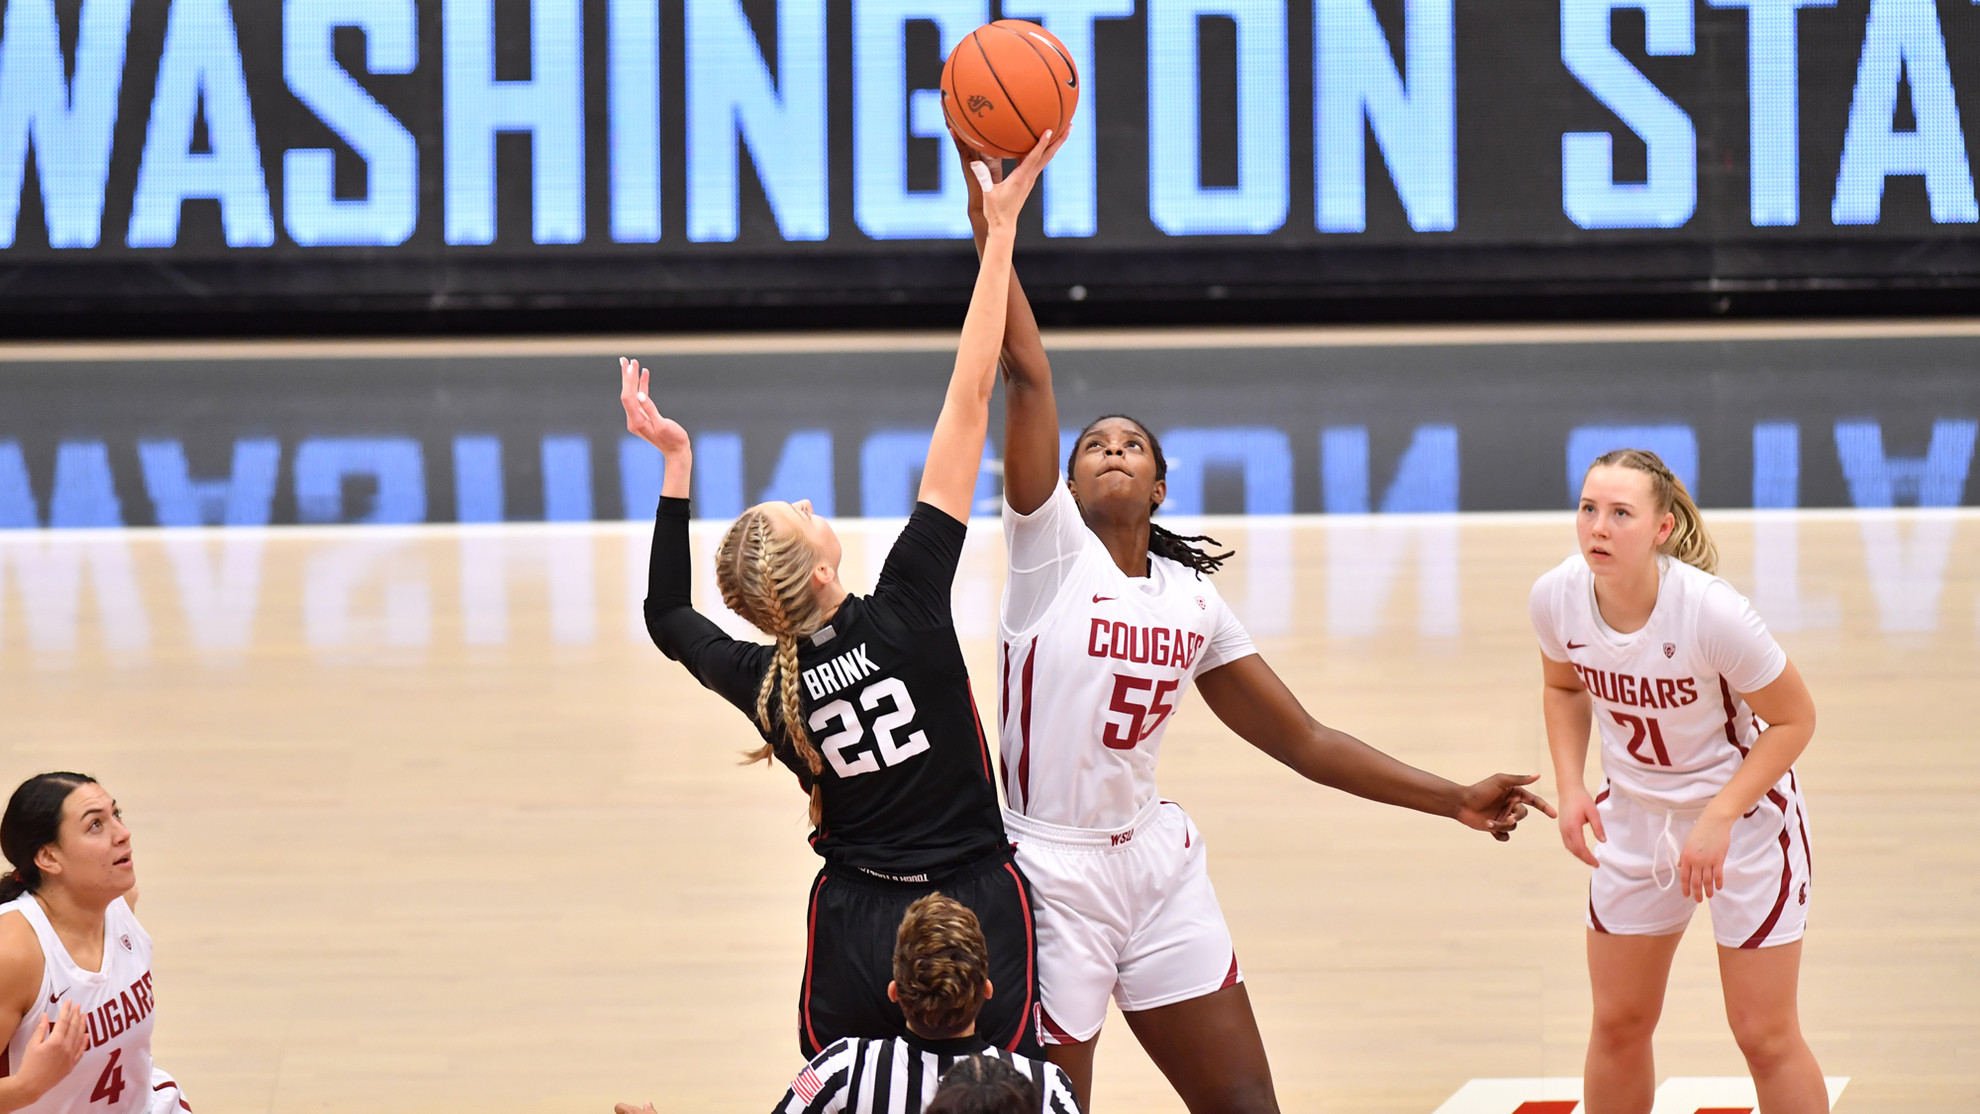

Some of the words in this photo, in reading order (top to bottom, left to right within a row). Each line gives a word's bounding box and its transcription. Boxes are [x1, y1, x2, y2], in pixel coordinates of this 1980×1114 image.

[0, 0, 1457, 248] WASHINGTON
[1560, 0, 1980, 230] STA
[802, 643, 880, 700] BRINK
[808, 677, 931, 778] 22
[1102, 673, 1180, 750] 55
[1608, 709, 1673, 767] 21
[1110, 828, 1135, 847] WSU
[49, 970, 155, 1052] UGARS
[90, 1047, 125, 1105] 4
